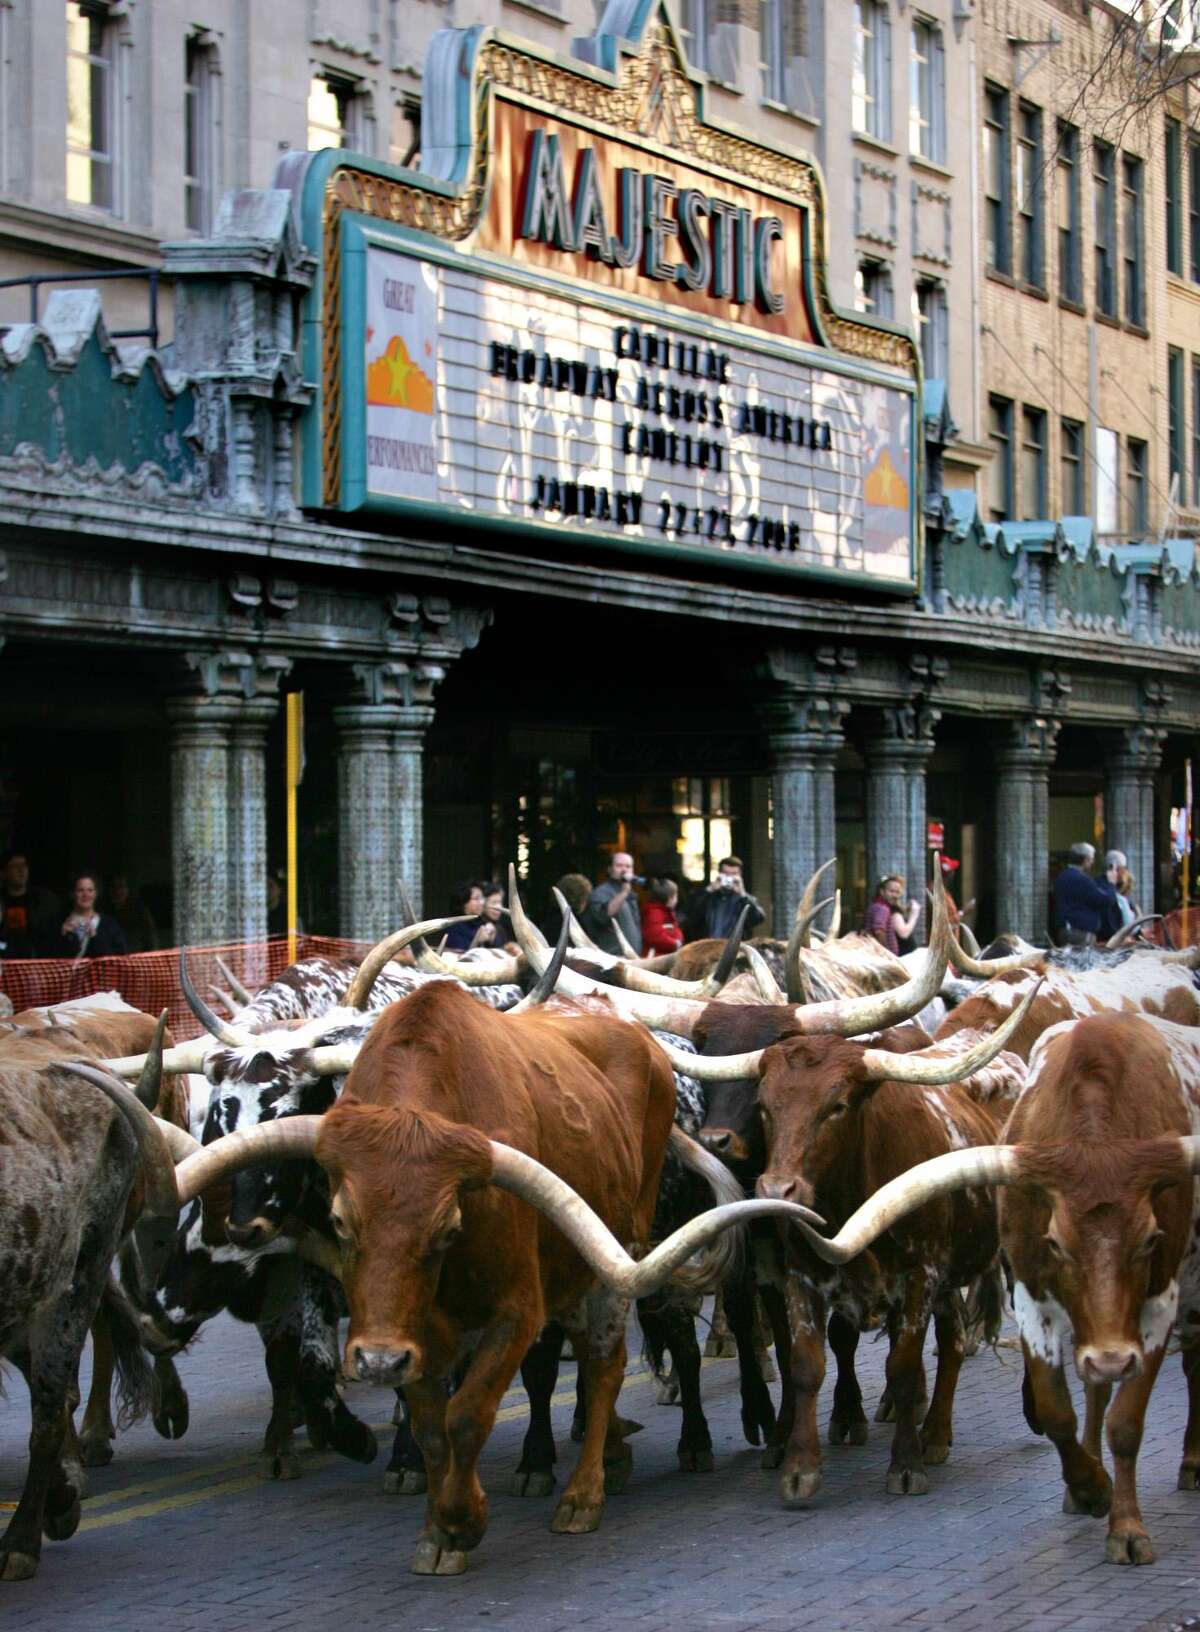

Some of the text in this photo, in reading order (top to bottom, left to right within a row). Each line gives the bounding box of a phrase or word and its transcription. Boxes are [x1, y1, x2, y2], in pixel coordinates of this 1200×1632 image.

[523, 128, 785, 315] MAJESTIC
[383, 277, 415, 314] GREAT
[615, 326, 729, 384] CADILLAC
[490, 340, 619, 401] BROADWAY
[638, 376, 724, 429] ACROSS
[739, 402, 832, 451] AMERICA
[368, 435, 435, 475] ERFORMANCES
[623, 421, 724, 473] CAMELOT
[531, 474, 643, 525] JANUARY
[748, 514, 800, 551] 2008
